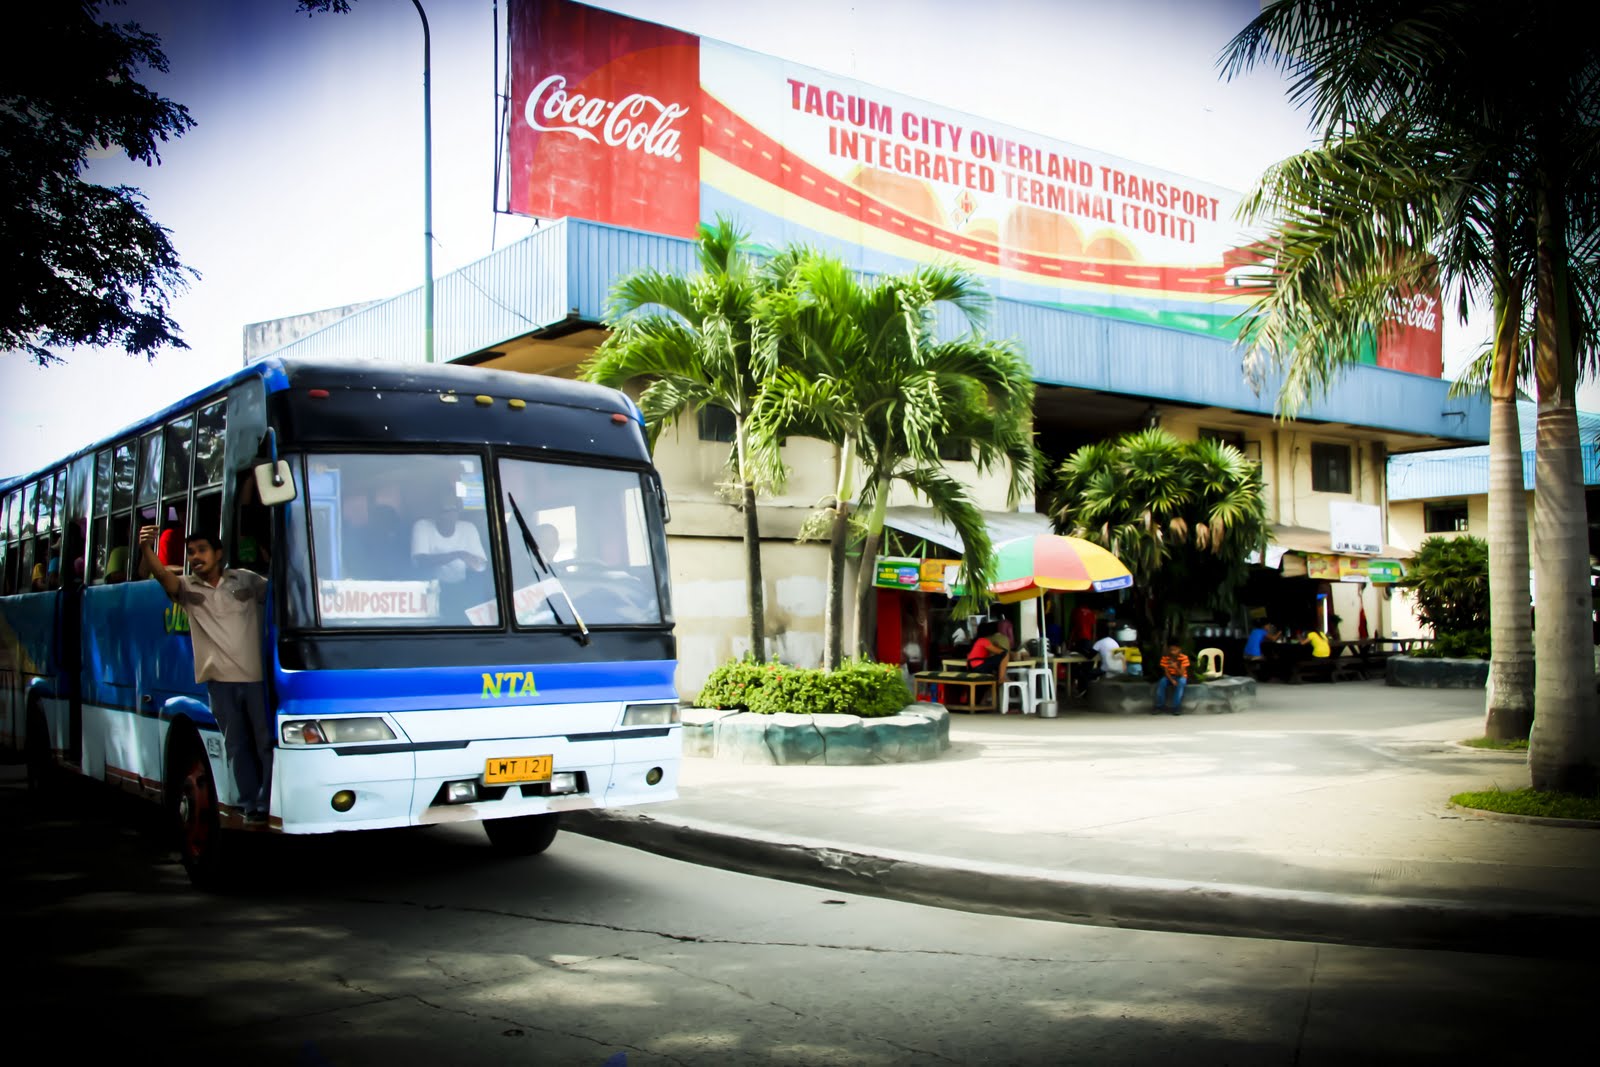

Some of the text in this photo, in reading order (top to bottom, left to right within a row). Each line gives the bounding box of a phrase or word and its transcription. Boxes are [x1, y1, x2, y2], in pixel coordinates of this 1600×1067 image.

[525, 75, 690, 159] Coca-Cola
[786, 78, 1220, 222] TAGUM CITY OVERLAND TRANSPORT
[828, 126, 995, 194] INTEGRATED
[1001, 171, 1117, 224] TERMINAL
[322, 590, 429, 613] COMPOSTELA
[481, 671, 541, 699] NTA
[488, 759, 547, 776] LWT 121
